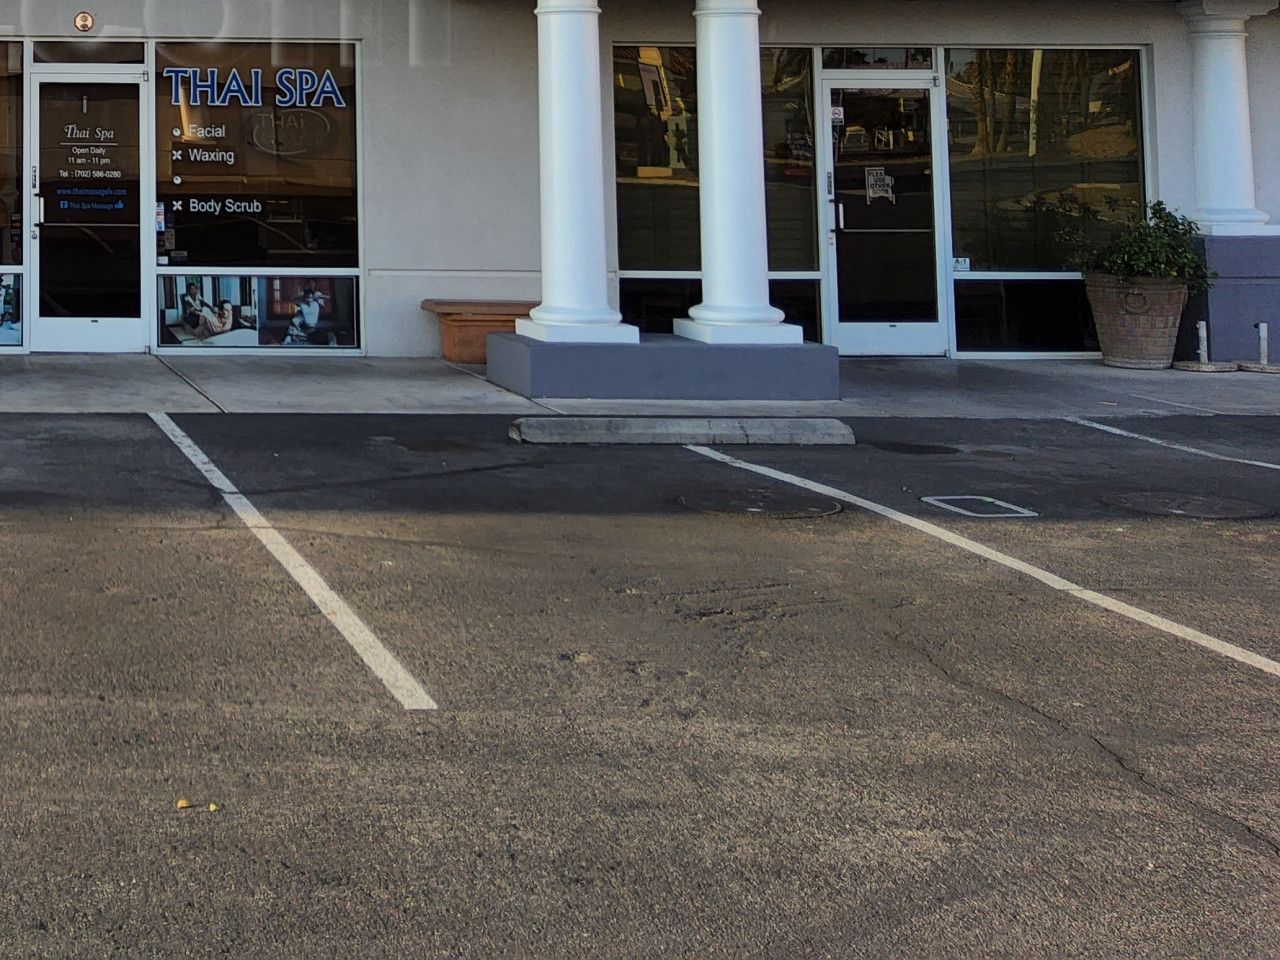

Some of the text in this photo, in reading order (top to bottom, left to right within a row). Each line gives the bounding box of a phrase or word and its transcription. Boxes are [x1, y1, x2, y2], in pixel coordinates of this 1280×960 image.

[163, 68, 347, 107] THAI SPA
[64, 124, 114, 140] Thai Spa
[188, 124, 226, 138] Facial
[72, 147, 106, 156] Open Daily
[188, 149, 235, 165] Waxing
[100, 158, 111, 166] pm
[74, 170, 91, 178] (702)
[189, 199, 262, 215] Body Scrub
